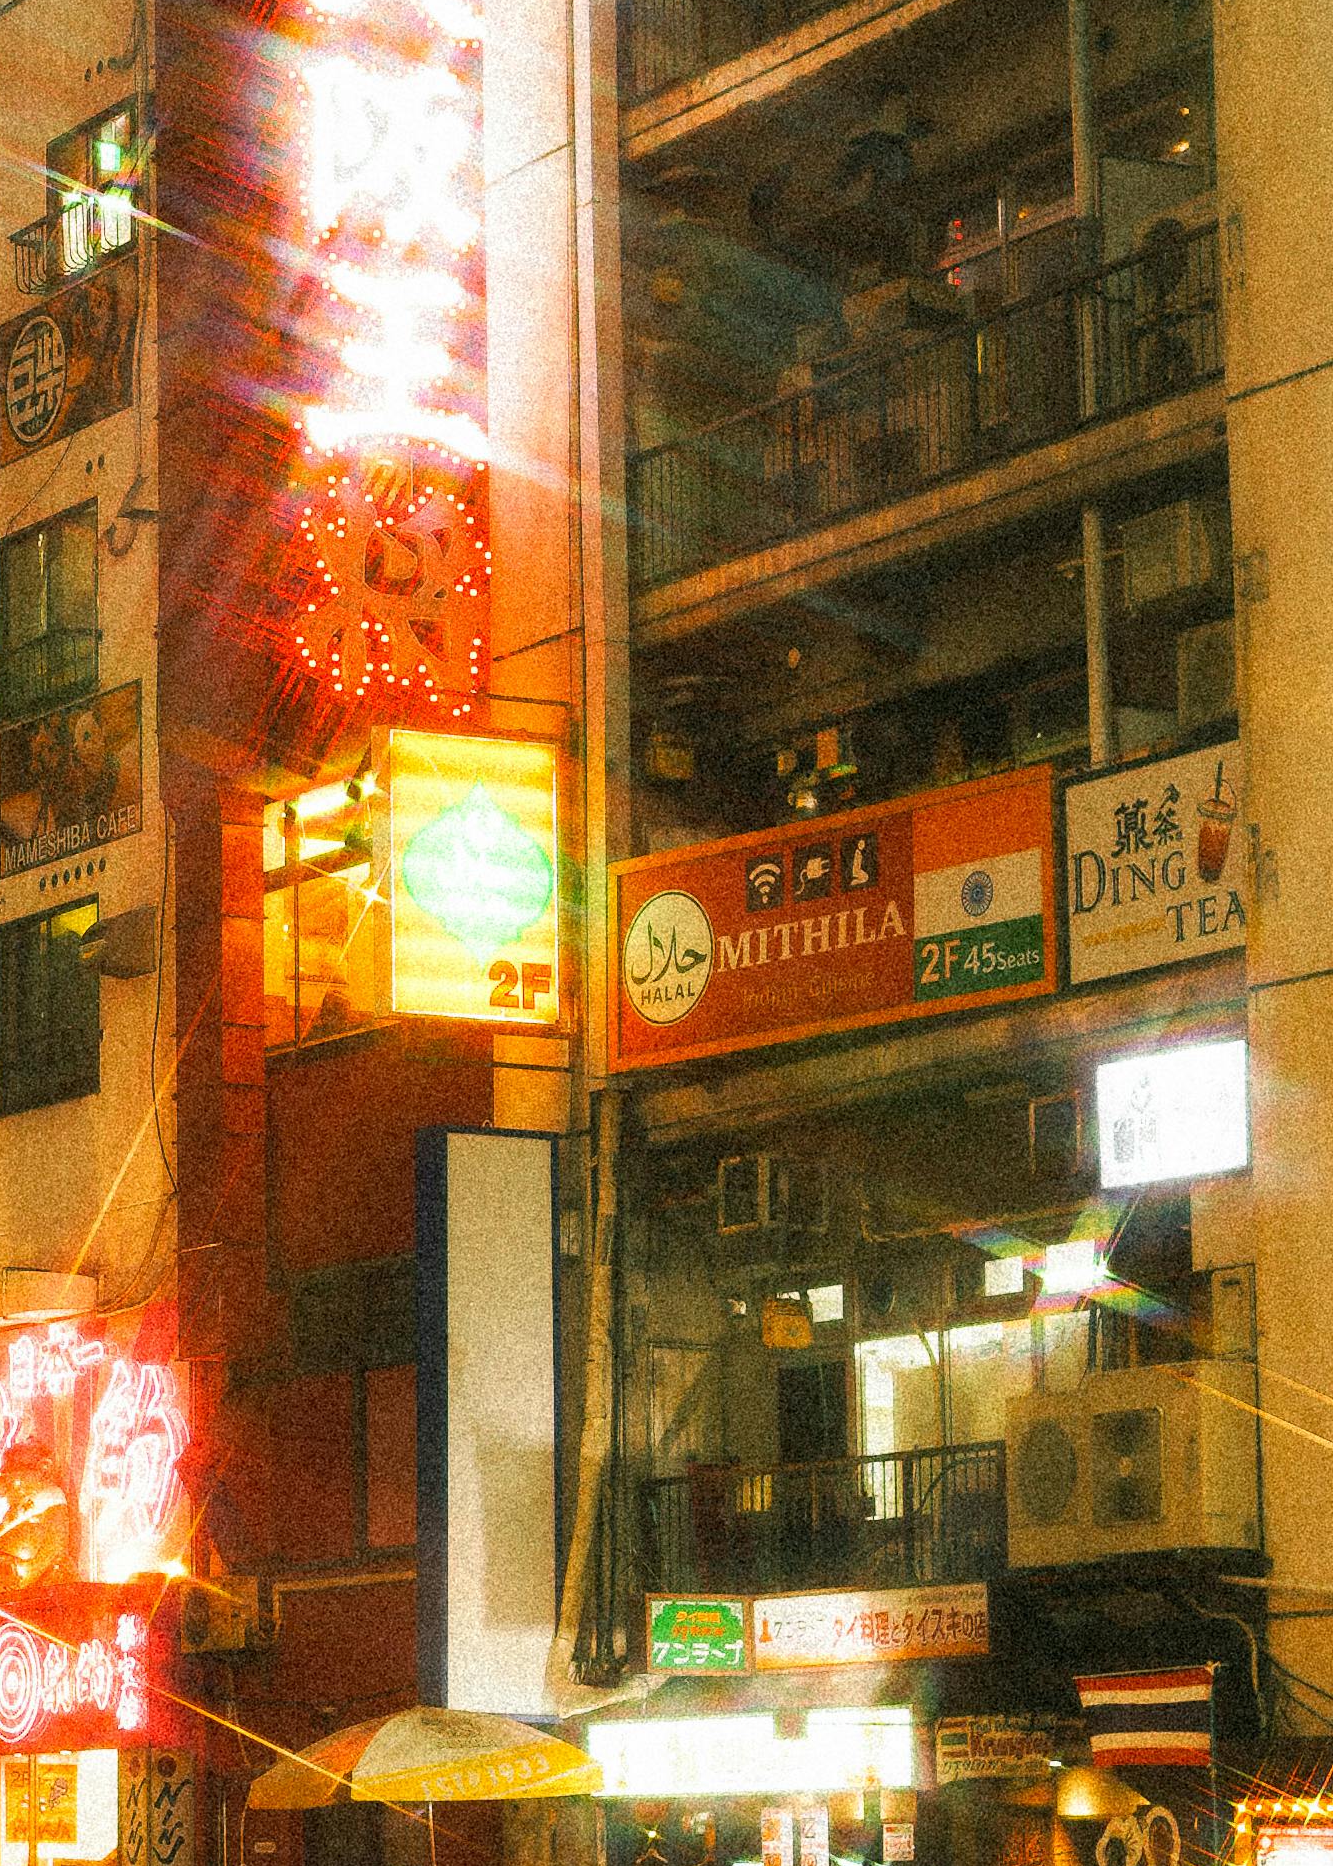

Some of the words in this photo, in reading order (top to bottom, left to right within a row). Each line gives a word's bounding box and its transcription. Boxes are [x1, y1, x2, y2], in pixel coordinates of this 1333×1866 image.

[4, 824, 90, 872] MAMESHIBA
[95, 802, 140, 850] CAFE
[1071, 849, 1187, 916] DING
[717, 900, 909, 973] MITHILA
[1166, 890, 1247, 945] TEA
[628, 919, 708, 984] حلال
[921, 939, 961, 985] 2F
[489, 961, 552, 1010] 2F
[639, 982, 697, 1006] HALAL
